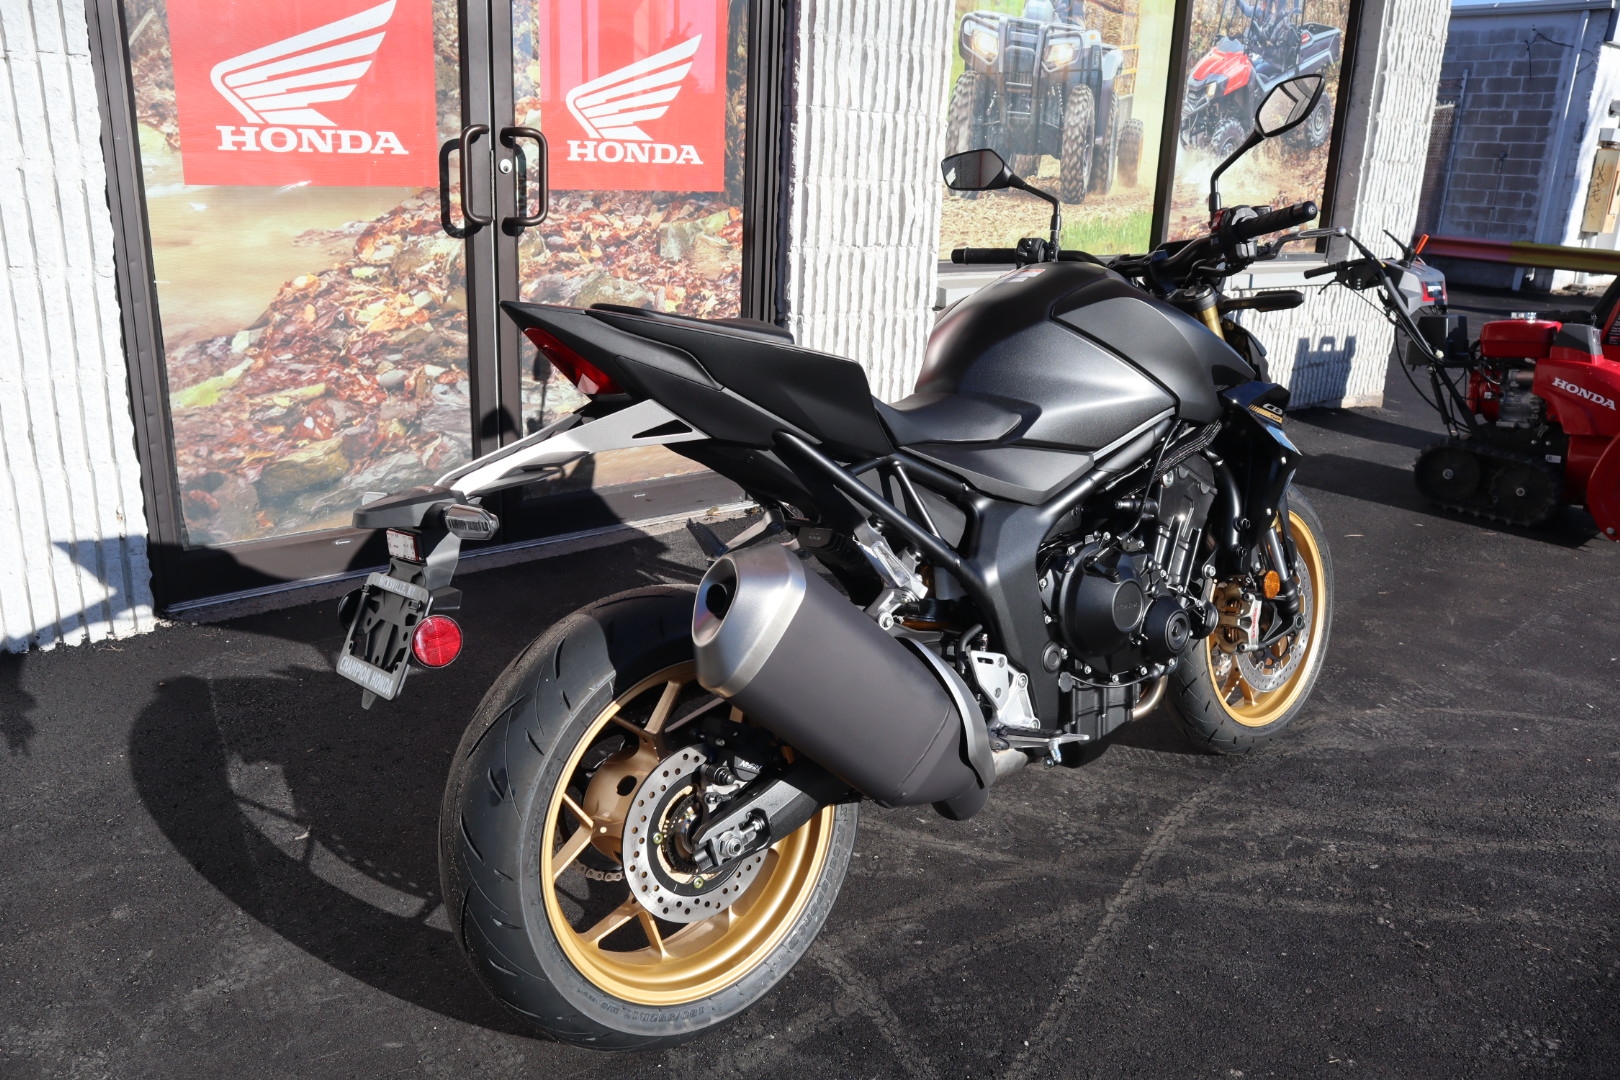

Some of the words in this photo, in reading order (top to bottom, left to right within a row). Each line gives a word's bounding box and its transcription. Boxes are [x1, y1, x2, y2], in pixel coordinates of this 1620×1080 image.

[216, 125, 409, 155] HONDA
[566, 140, 704, 165] HONDA
[1552, 377, 1616, 411] HONDA
[339, 655, 370, 684] CHAMPION
[369, 672, 394, 696] HONDA
